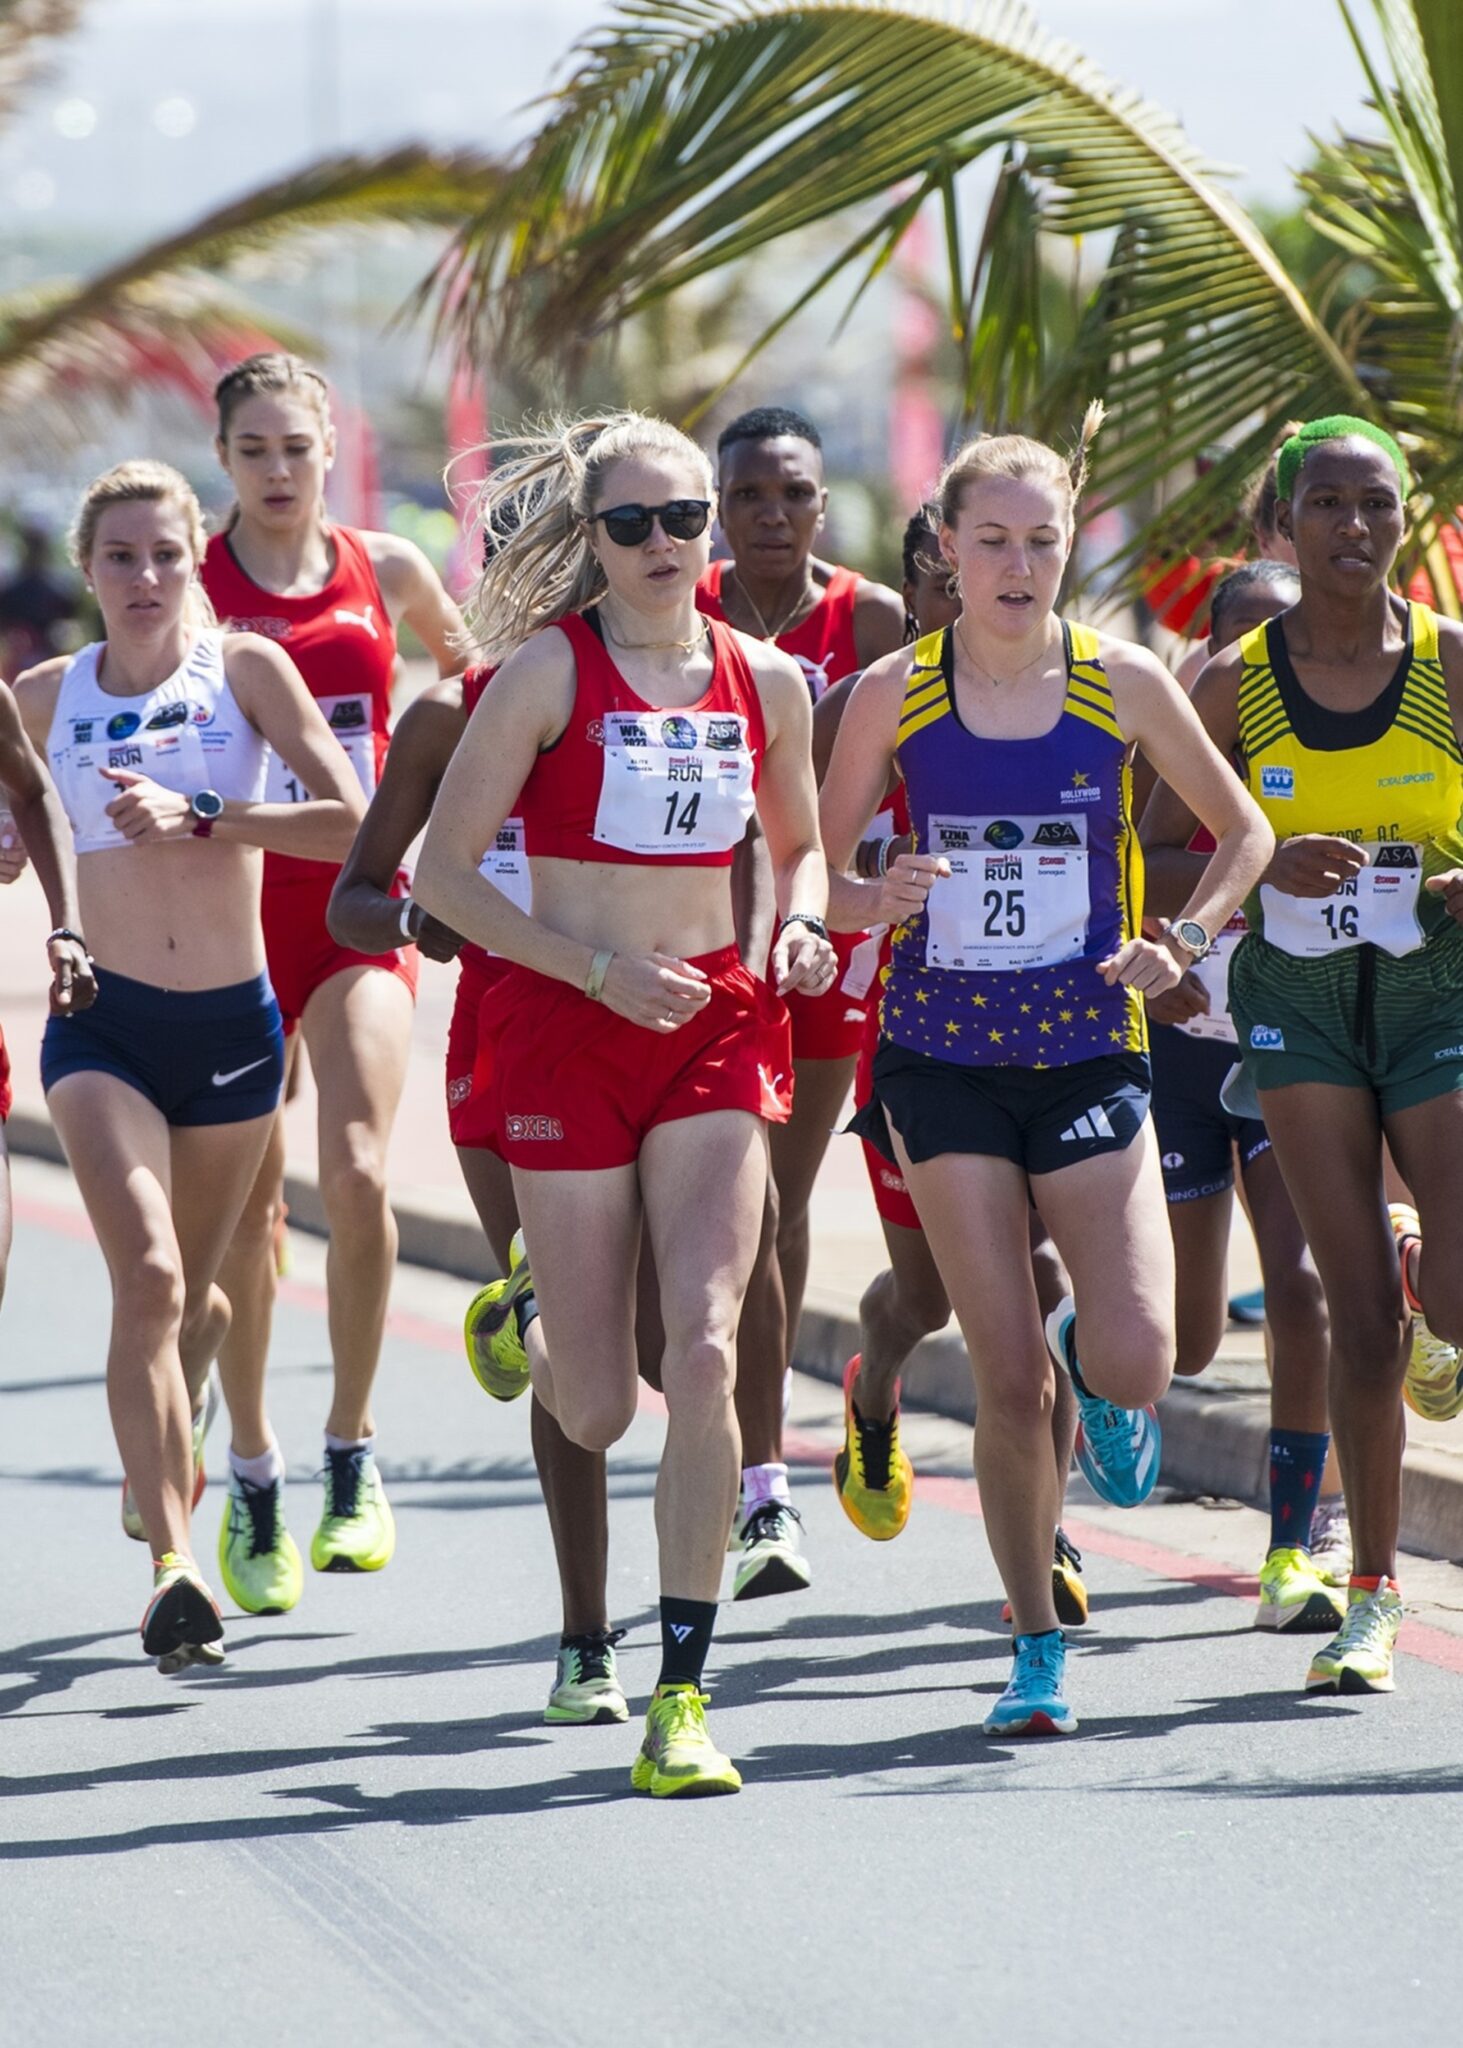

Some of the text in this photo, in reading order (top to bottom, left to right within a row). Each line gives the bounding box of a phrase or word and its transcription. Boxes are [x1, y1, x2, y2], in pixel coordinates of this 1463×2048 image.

[619, 725, 647, 737] WPA
[710, 723, 741, 738] ASA
[109, 750, 143, 768] RUN
[668, 764, 703, 782] RUN
[1377, 772, 1436, 788] TOTALSPORTS
[1060, 787, 1101, 799] HOLLYWOOD
[663, 790, 701, 836] 14
[496, 831, 517, 843] CGA
[940, 829, 970, 841] KZNA
[1039, 825, 1075, 839] ASA
[1377, 824, 1404, 842] A.C.
[1379, 848, 1414, 862] ASA
[985, 863, 1022, 880] RUN
[1336, 879, 1358, 897] UN
[983, 889, 1025, 937] 25
[1321, 904, 1359, 940] 16
[507, 1115, 564, 1140] OXER
[1247, 1139, 1272, 1161] XCEL
